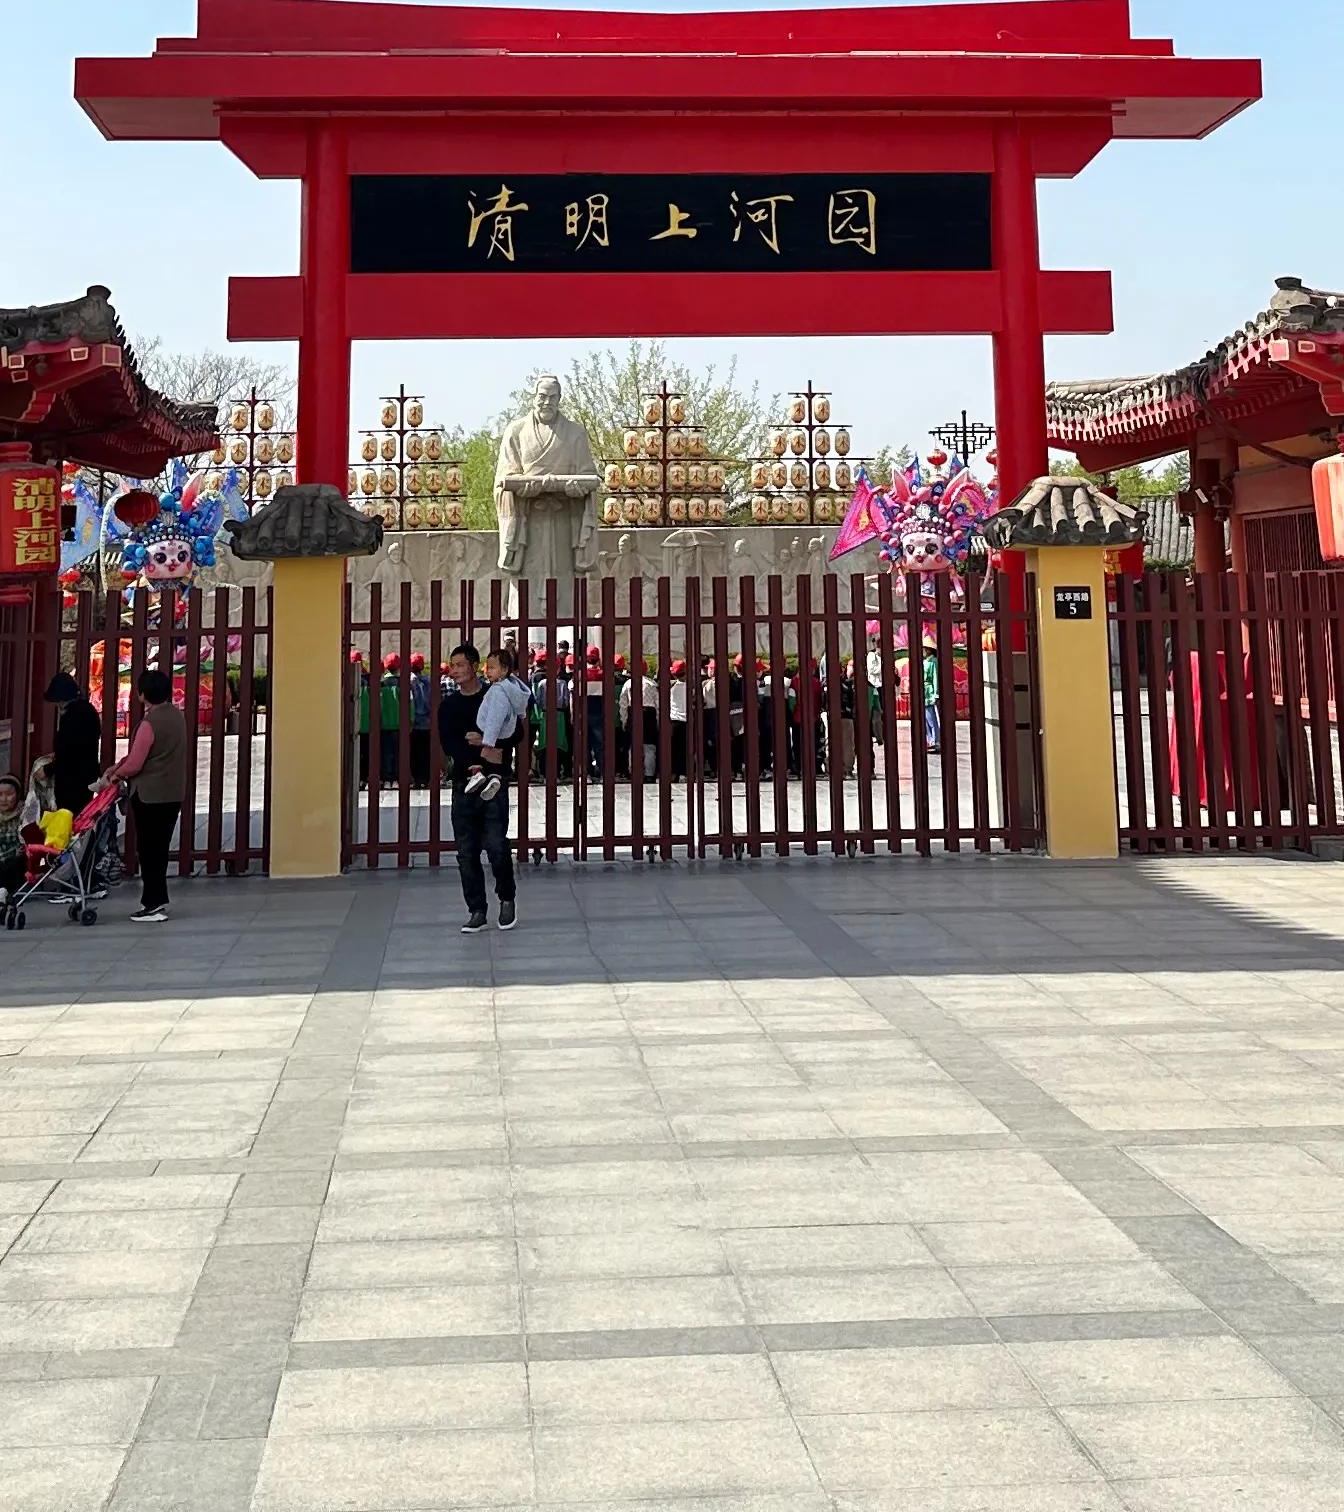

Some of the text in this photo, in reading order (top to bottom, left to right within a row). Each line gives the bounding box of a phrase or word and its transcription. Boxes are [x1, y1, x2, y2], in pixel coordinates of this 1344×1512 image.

[467, 183, 876, 261] 清明上河园
[11, 477, 57, 566] 清明上河园
[1069, 602, 1077, 615] 5
